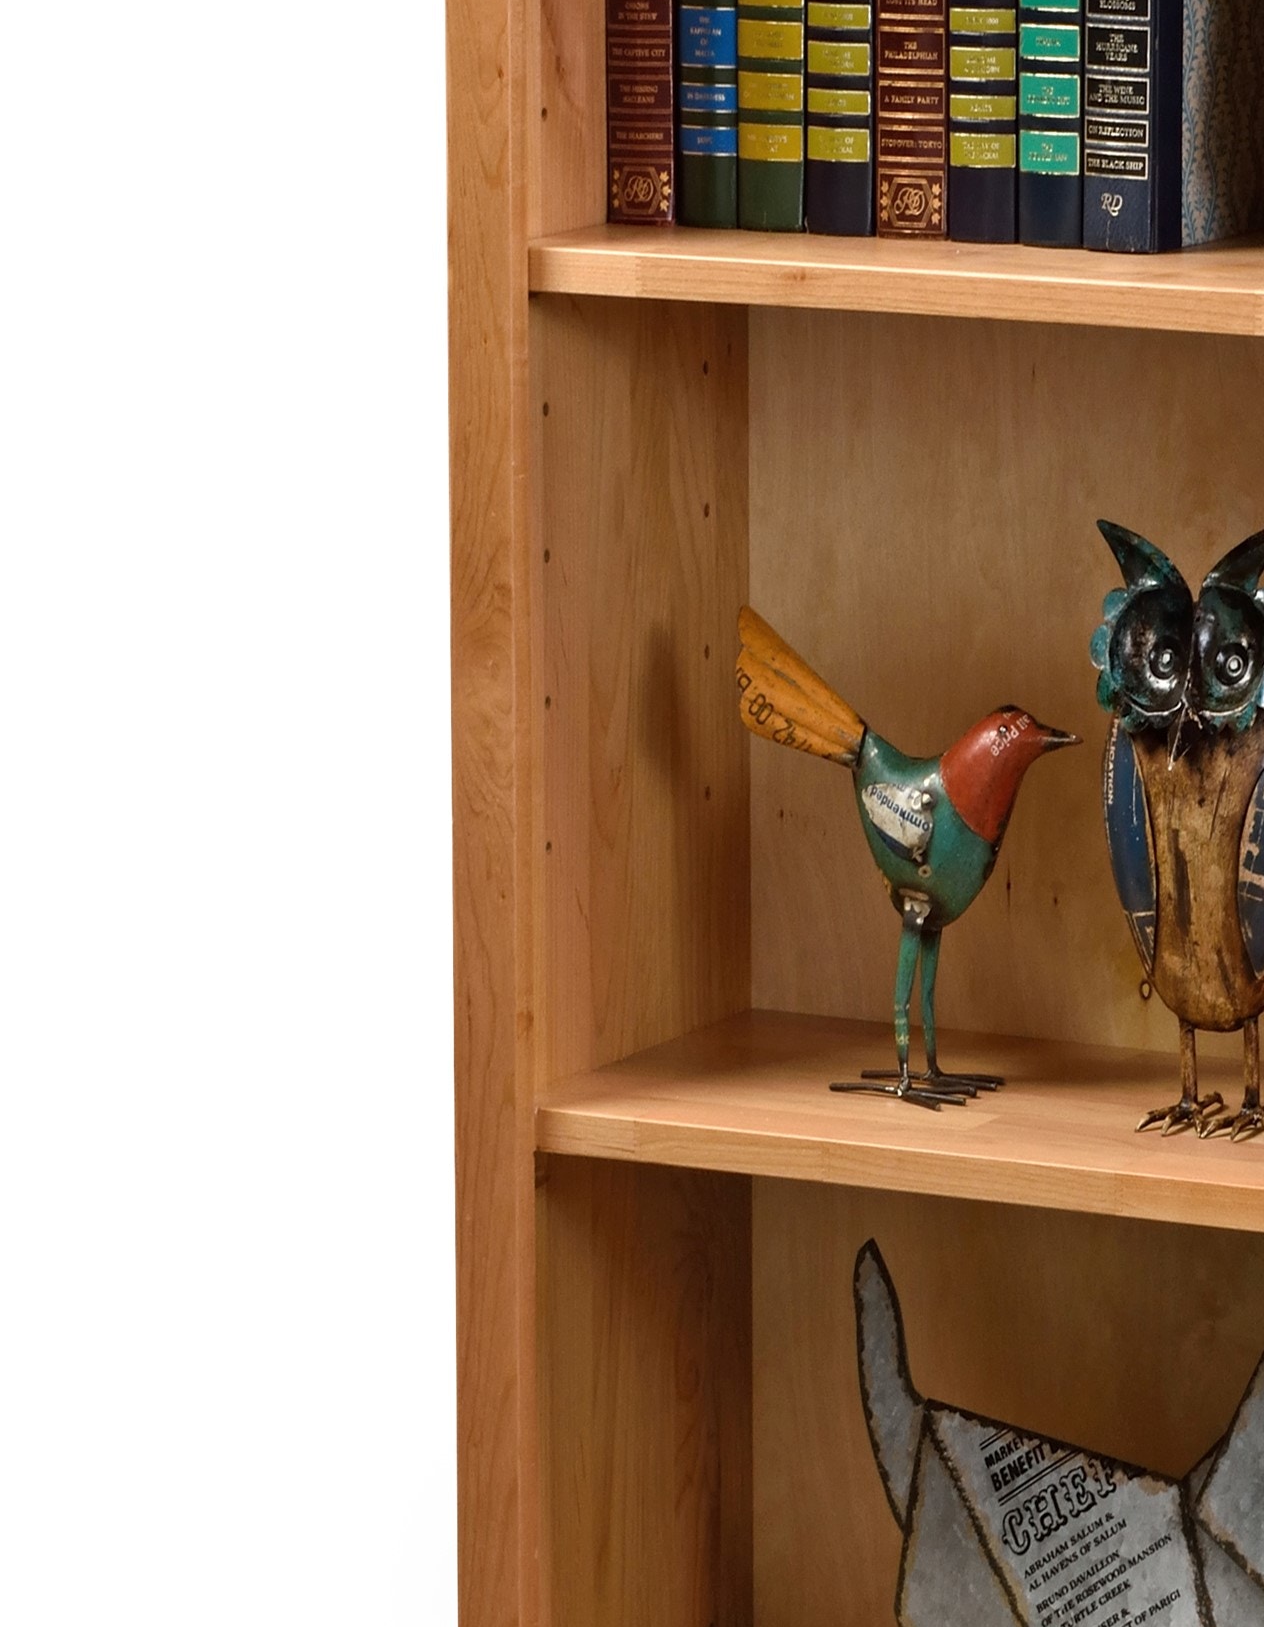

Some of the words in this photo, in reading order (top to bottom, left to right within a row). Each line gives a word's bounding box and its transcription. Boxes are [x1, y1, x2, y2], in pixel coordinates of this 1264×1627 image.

[1109, 34, 1124, 43] THE
[904, 41, 918, 50] THE
[651, 49, 666, 57] CITY
[884, 50, 938, 60] PHILADELPHIAN
[1105, 51, 1128, 62] YEARS
[1098, 84, 1113, 93] THE
[1113, 85, 1133, 95] WINE
[884, 95, 890, 103] A
[891, 95, 915, 104] FAMILY
[917, 96, 939, 105] PARTY
[1089, 94, 1103, 103] AND
[1104, 94, 1119, 104] THE
[1121, 95, 1145, 105] MUSIC
[1088, 125, 1098, 134] ON
[1098, 126, 1144, 138] REFLECTION
[918, 140, 942, 149] TOKYO
[1088, 158, 1100, 167] THE
[1101, 159, 1125, 169] BLACK
[1126, 160, 1144, 170] SHIP
[990, 725, 1020, 757] Price
[990, 1443, 1046, 1492] BENEFIT
[1024, 1542, 1069, 1579] ABRAHAM
[1070, 1517, 1103, 1545] SALUM
[1029, 1579, 1042, 1593] AL
[1042, 1552, 1079, 1583] HAVENS
[1079, 1541, 1094, 1556] OF
[1093, 1518, 1127, 1546] SALUM
[1075, 1564, 1128, 1604] ROSEWOOD
[1128, 1533, 1173, 1569] MANSION
[1036, 1584, 1069, 1614] BRUNO
[1070, 1550, 1122, 1591] DAVAILLON
[1098, 1578, 1132, 1607] CREEK
[1134, 1610, 1148, 1626] OF
[1148, 1589, 1182, 1617] PARIGI
